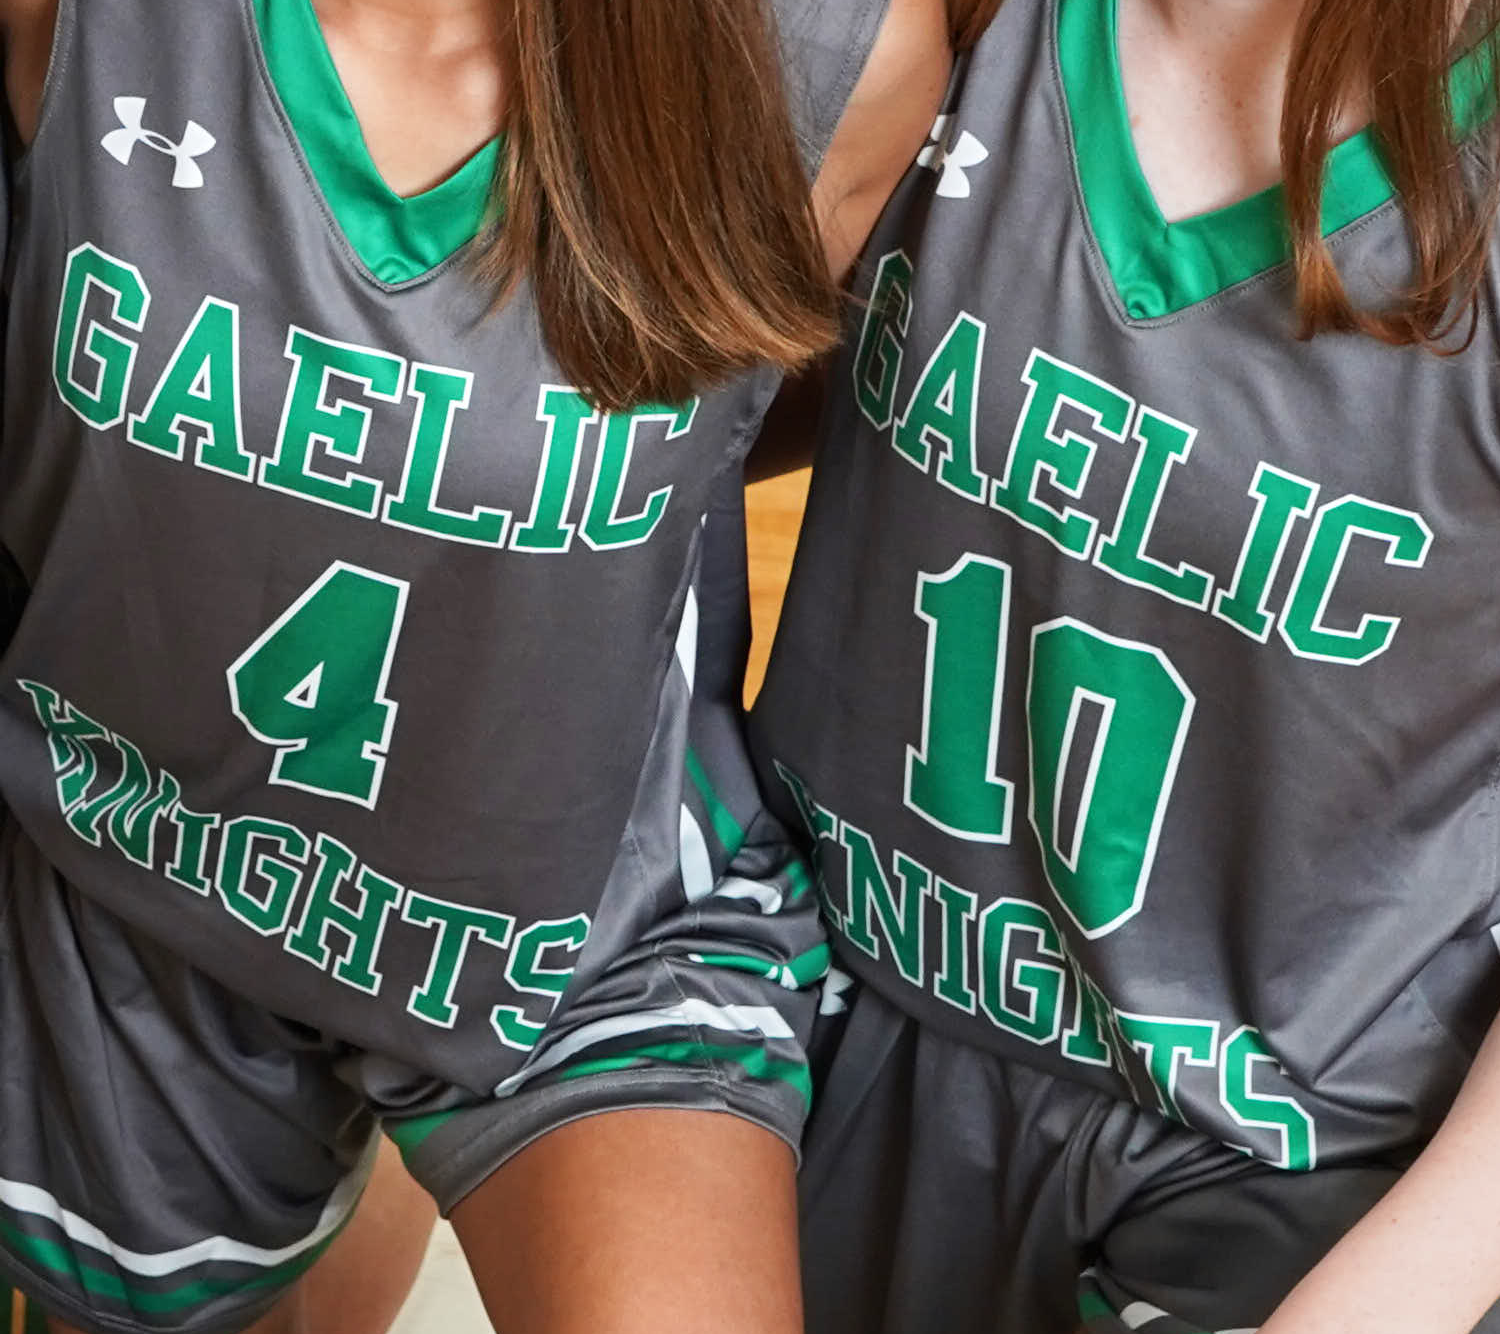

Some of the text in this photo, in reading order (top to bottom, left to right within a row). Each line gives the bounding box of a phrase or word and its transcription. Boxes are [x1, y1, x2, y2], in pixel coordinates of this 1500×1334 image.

[52, 240, 701, 554] GAELIC
[852, 247, 1435, 667] GAELIC
[16, 677, 592, 1052] KNIGHTS
[226, 558, 412, 811] 4
[903, 551, 1197, 940] 10
